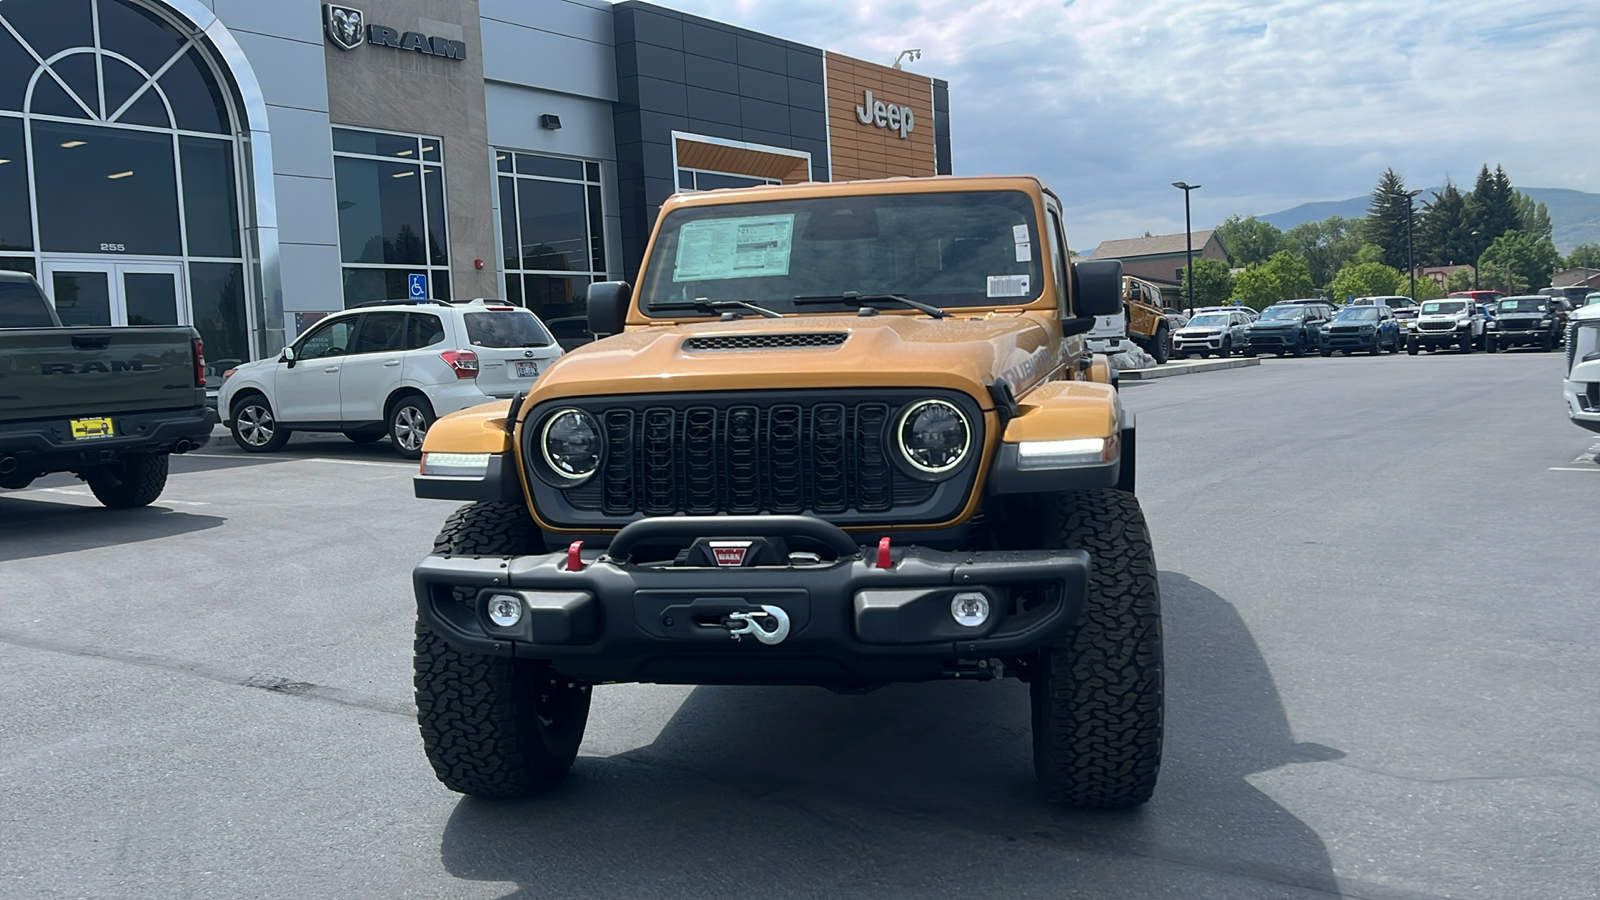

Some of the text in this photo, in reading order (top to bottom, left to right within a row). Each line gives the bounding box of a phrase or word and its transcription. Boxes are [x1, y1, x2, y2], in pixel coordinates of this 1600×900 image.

[367, 24, 466, 61] RAM
[856, 89, 914, 139] Jeep
[100, 243, 126, 252] 255
[41, 359, 143, 376] RAM
